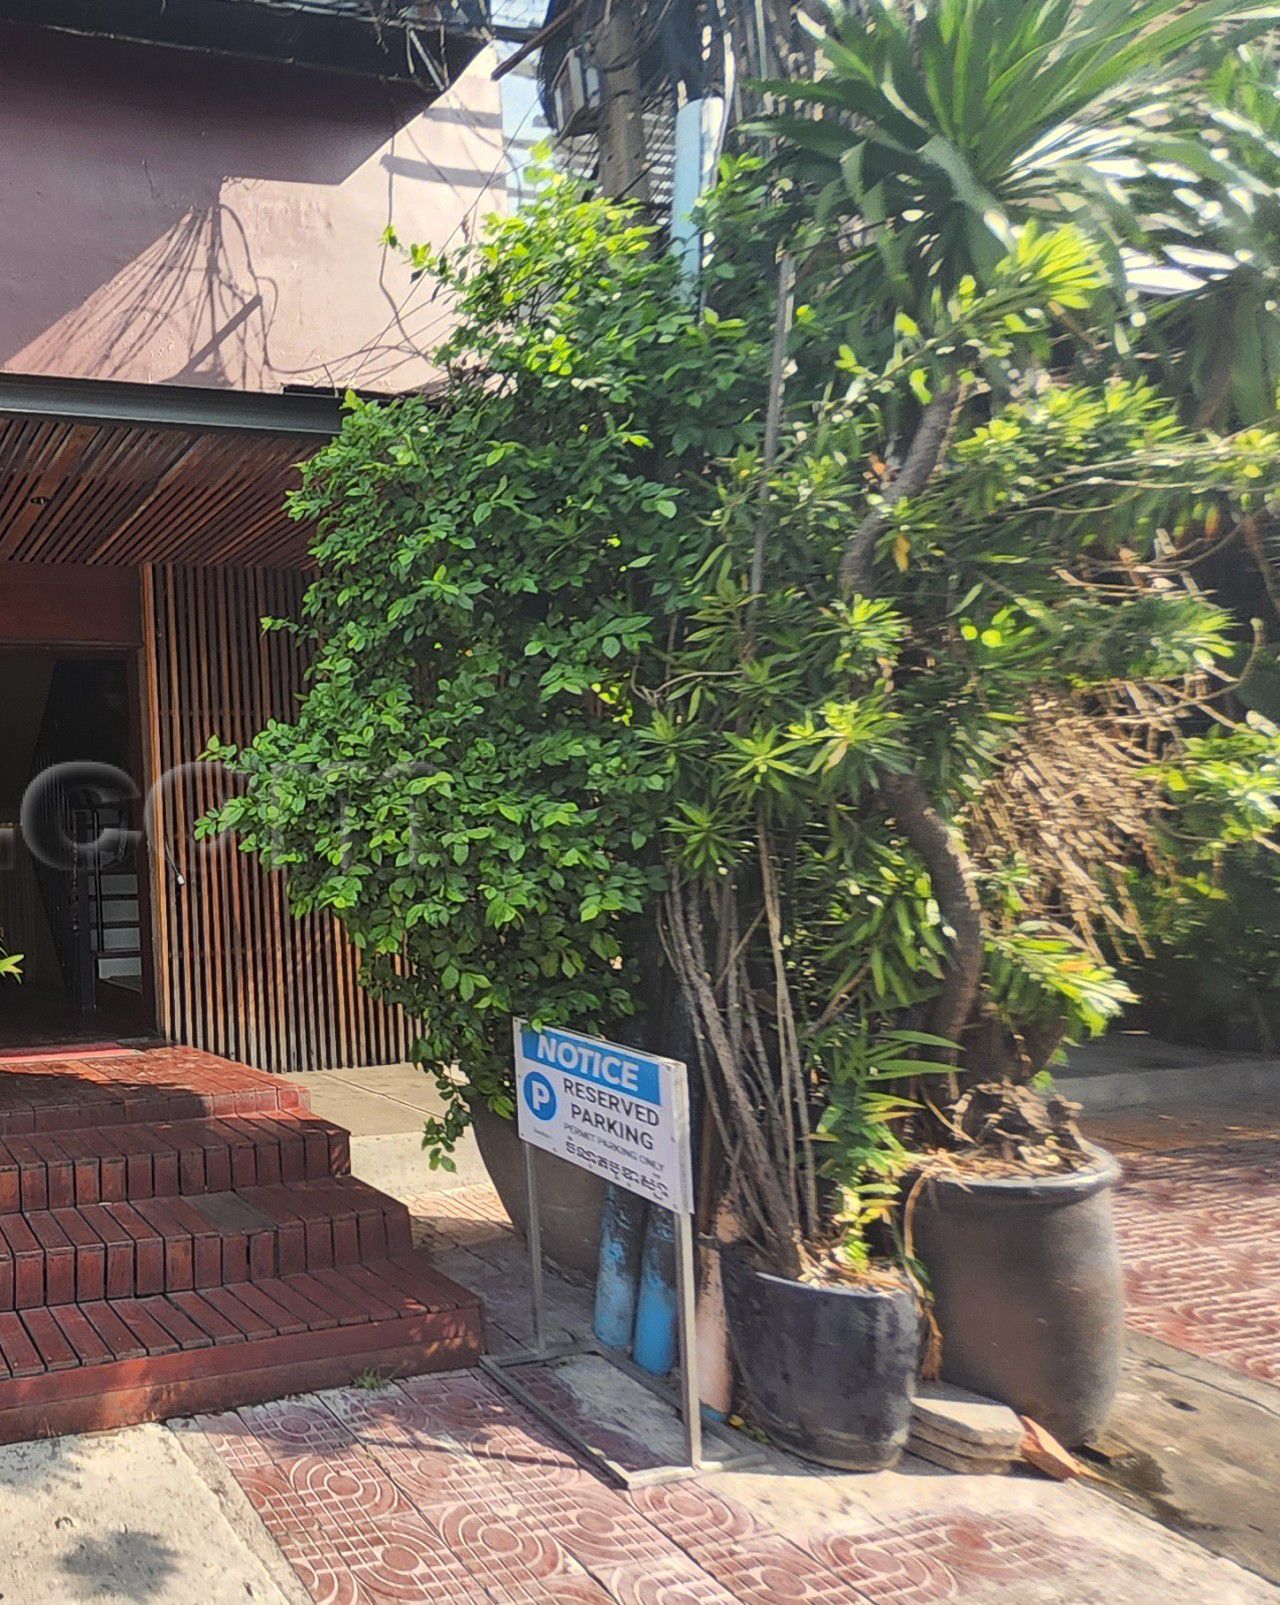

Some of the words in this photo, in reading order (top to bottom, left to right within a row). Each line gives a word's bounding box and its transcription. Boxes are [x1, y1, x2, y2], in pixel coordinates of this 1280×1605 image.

[536, 1034, 640, 1093] NOTICE
[562, 1076, 660, 1127] RESERVED
[571, 1103, 655, 1150] PARKING
[563, 1122, 595, 1142] PERMIT
[597, 1137, 638, 1161] PARKING
[639, 1155, 665, 1173] ONLY
